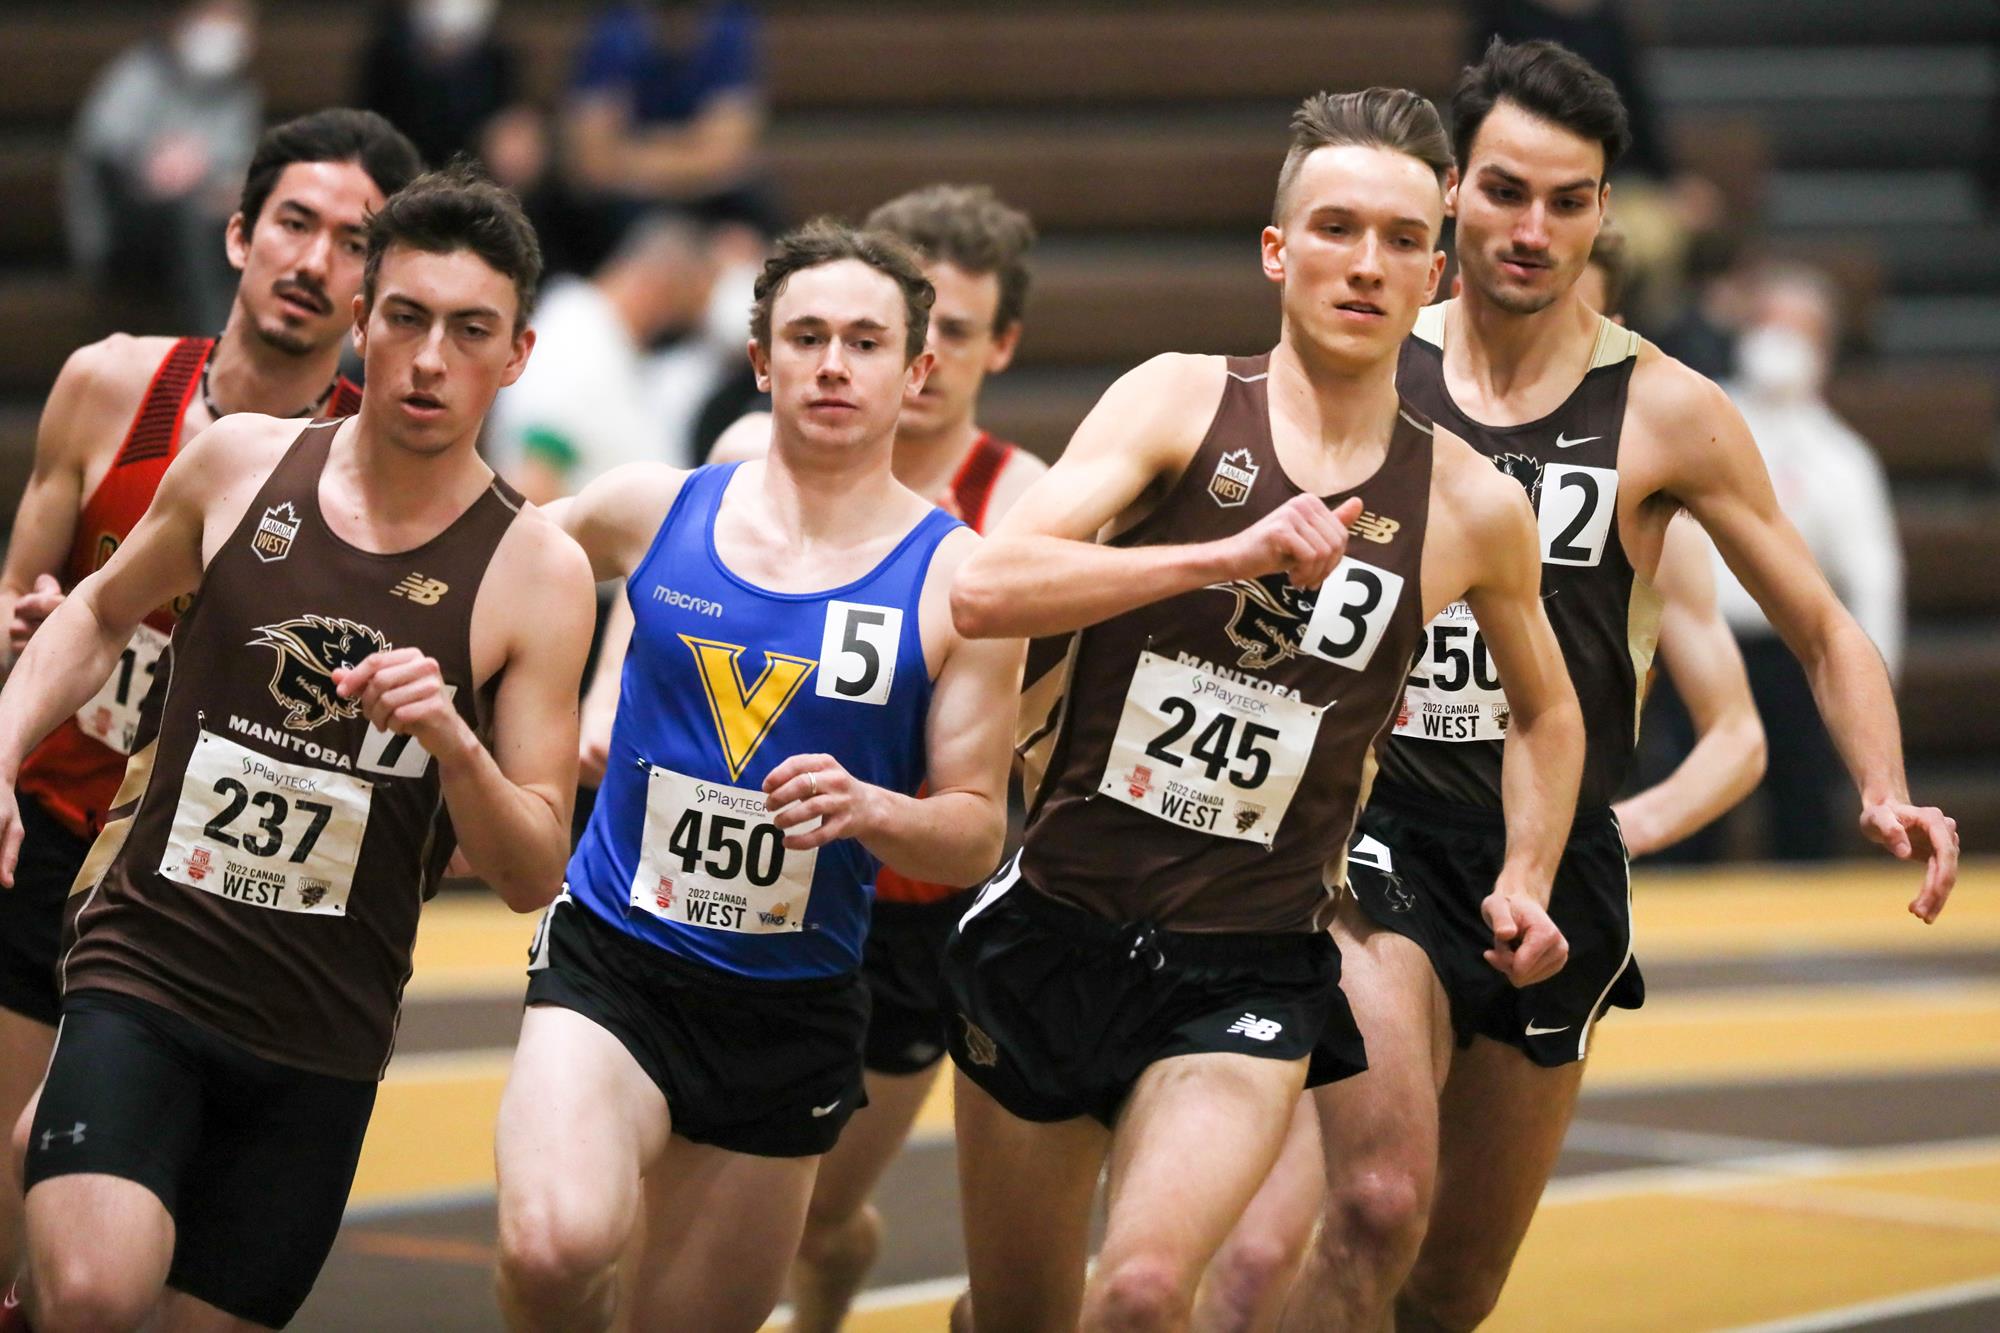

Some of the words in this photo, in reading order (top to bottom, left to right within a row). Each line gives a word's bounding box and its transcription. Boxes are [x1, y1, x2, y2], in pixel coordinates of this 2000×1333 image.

[1213, 477, 1247, 501] WEST
[1219, 465, 1251, 485] CANADA
[261, 518, 293, 539] CANADA
[1548, 471, 1600, 562] 2
[257, 531, 289, 555] WEST
[653, 585, 723, 618] macron
[1318, 568, 1382, 659] 3
[834, 609, 886, 697] 5
[1177, 650, 1302, 703] MANITOBA
[677, 633, 819, 784] V
[1204, 681, 1269, 713] PlayTECK
[1423, 702, 1442, 714] 2022
[1445, 704, 1480, 715] CANADA
[1423, 714, 1480, 738] WEST
[229, 715, 352, 770] MANITOBA
[1144, 696, 1280, 790] 245
[253, 762, 317, 792] PlayTECK
[1166, 780, 1189, 797] 2022
[1190, 790, 1224, 807] CANADA
[203, 777, 333, 864] 237
[1161, 791, 1222, 830] WEST
[668, 808, 786, 887] 450
[226, 861, 249, 877] 2022
[250, 867, 286, 884] CANADA
[223, 872, 286, 906] WEST
[688, 887, 711, 901] 2022
[712, 891, 747, 907] CANADA
[686, 898, 746, 929] WEST
